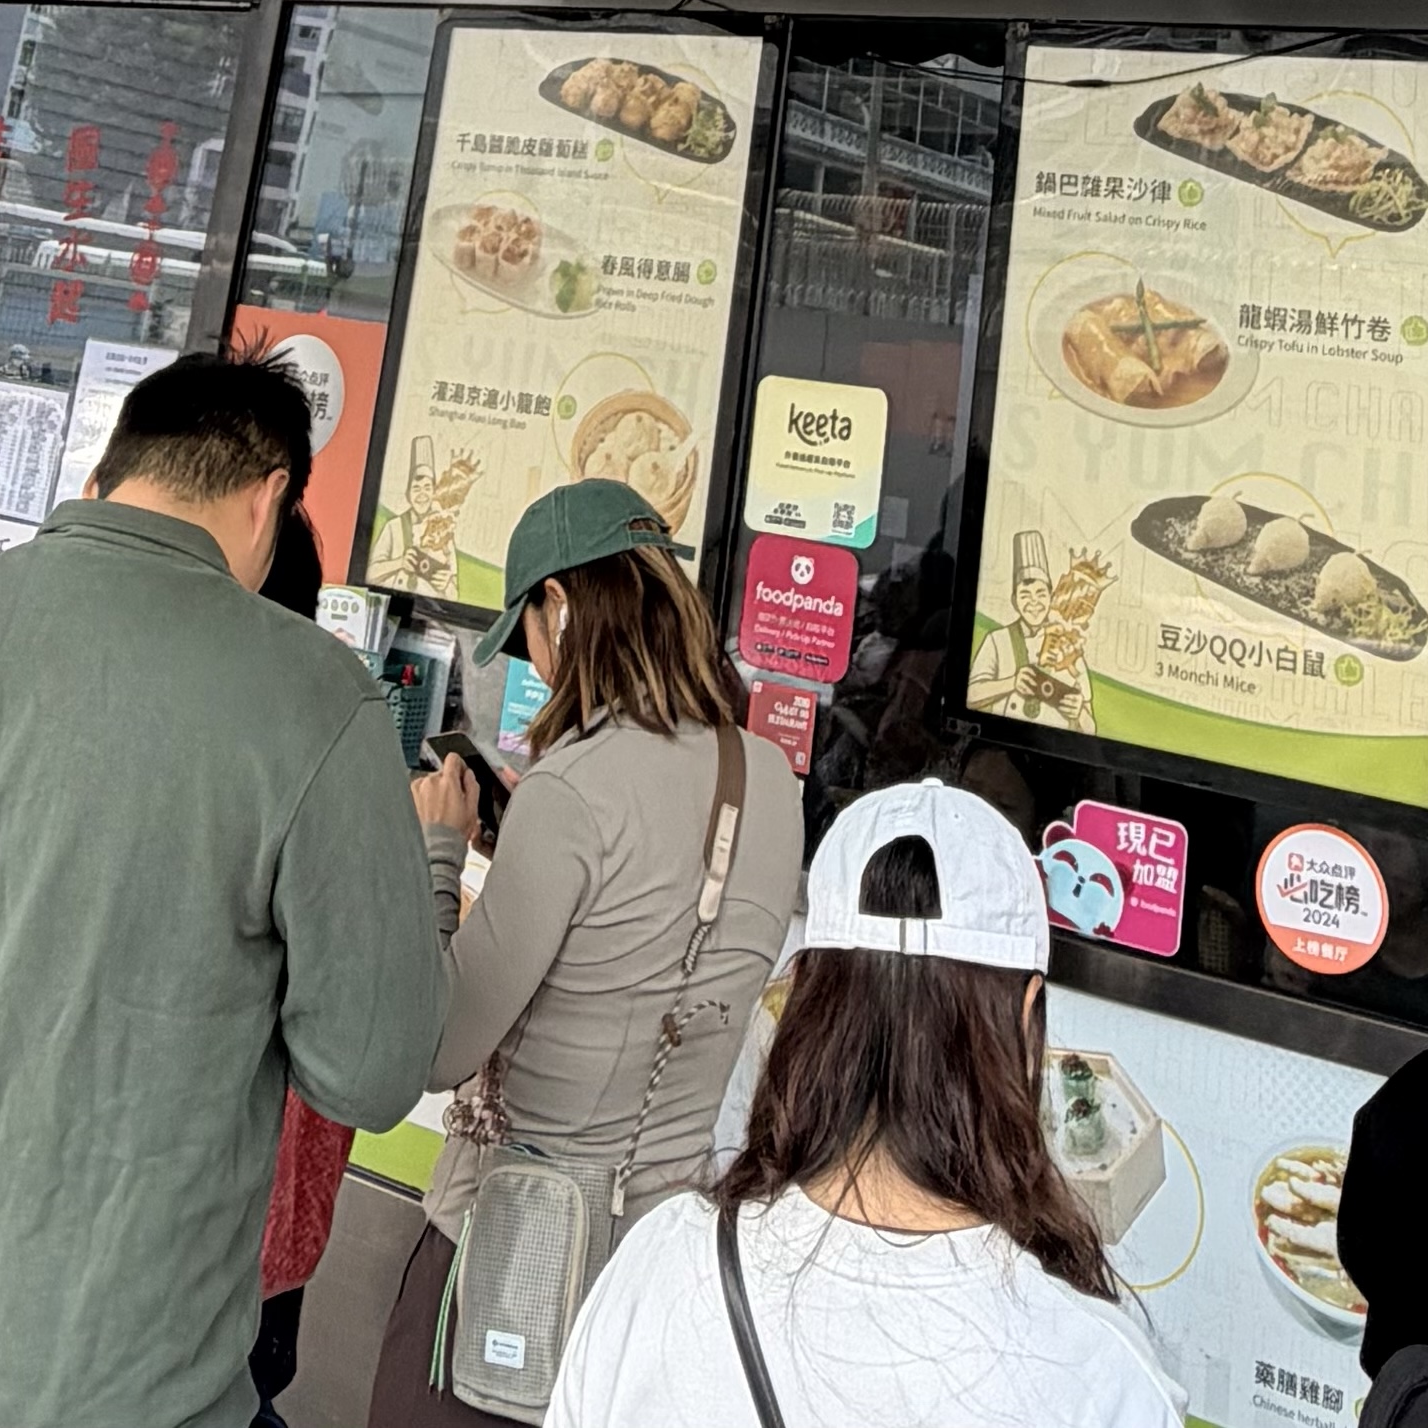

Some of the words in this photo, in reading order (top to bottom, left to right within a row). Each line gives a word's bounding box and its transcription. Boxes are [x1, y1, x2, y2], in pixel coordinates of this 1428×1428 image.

[1034, 170, 1172, 205] 鍋巴雜果沙律
[1033, 206, 1065, 221] Mixed
[1066, 209, 1092, 222] Fruit
[1095, 211, 1126, 225] Salad
[1128, 215, 1143, 226] on
[1145, 215, 1180, 232] Crispy
[1183, 219, 1208, 232] Rice
[1238, 302, 1392, 343] 龍蝦湯鮮竹卷
[1238, 334, 1275, 353] Crispy
[1277, 337, 1305, 354] Tofu
[1306, 342, 1319, 355] in
[1322, 343, 1368, 360] Lobster
[1371, 349, 1404, 367] Soup
[787, 402, 853, 447] keeta
[755, 580, 844, 617] foodpanda
[1156, 622, 1326, 680] 豆沙QQ小白鼠
[1154, 661, 1165, 678] 3
[1166, 663, 1220, 687] Monchi
[1222, 673, 1257, 694] Mice
[1115, 820, 1177, 865] 現已
[1131, 858, 1179, 895] 加盟
[1305, 857, 1357, 881] 大众点评
[1302, 906, 1341, 929] 2024
[1254, 1359, 1344, 1414] 藥膳雞腳
[1252, 1393, 1296, 1421] Chinese
